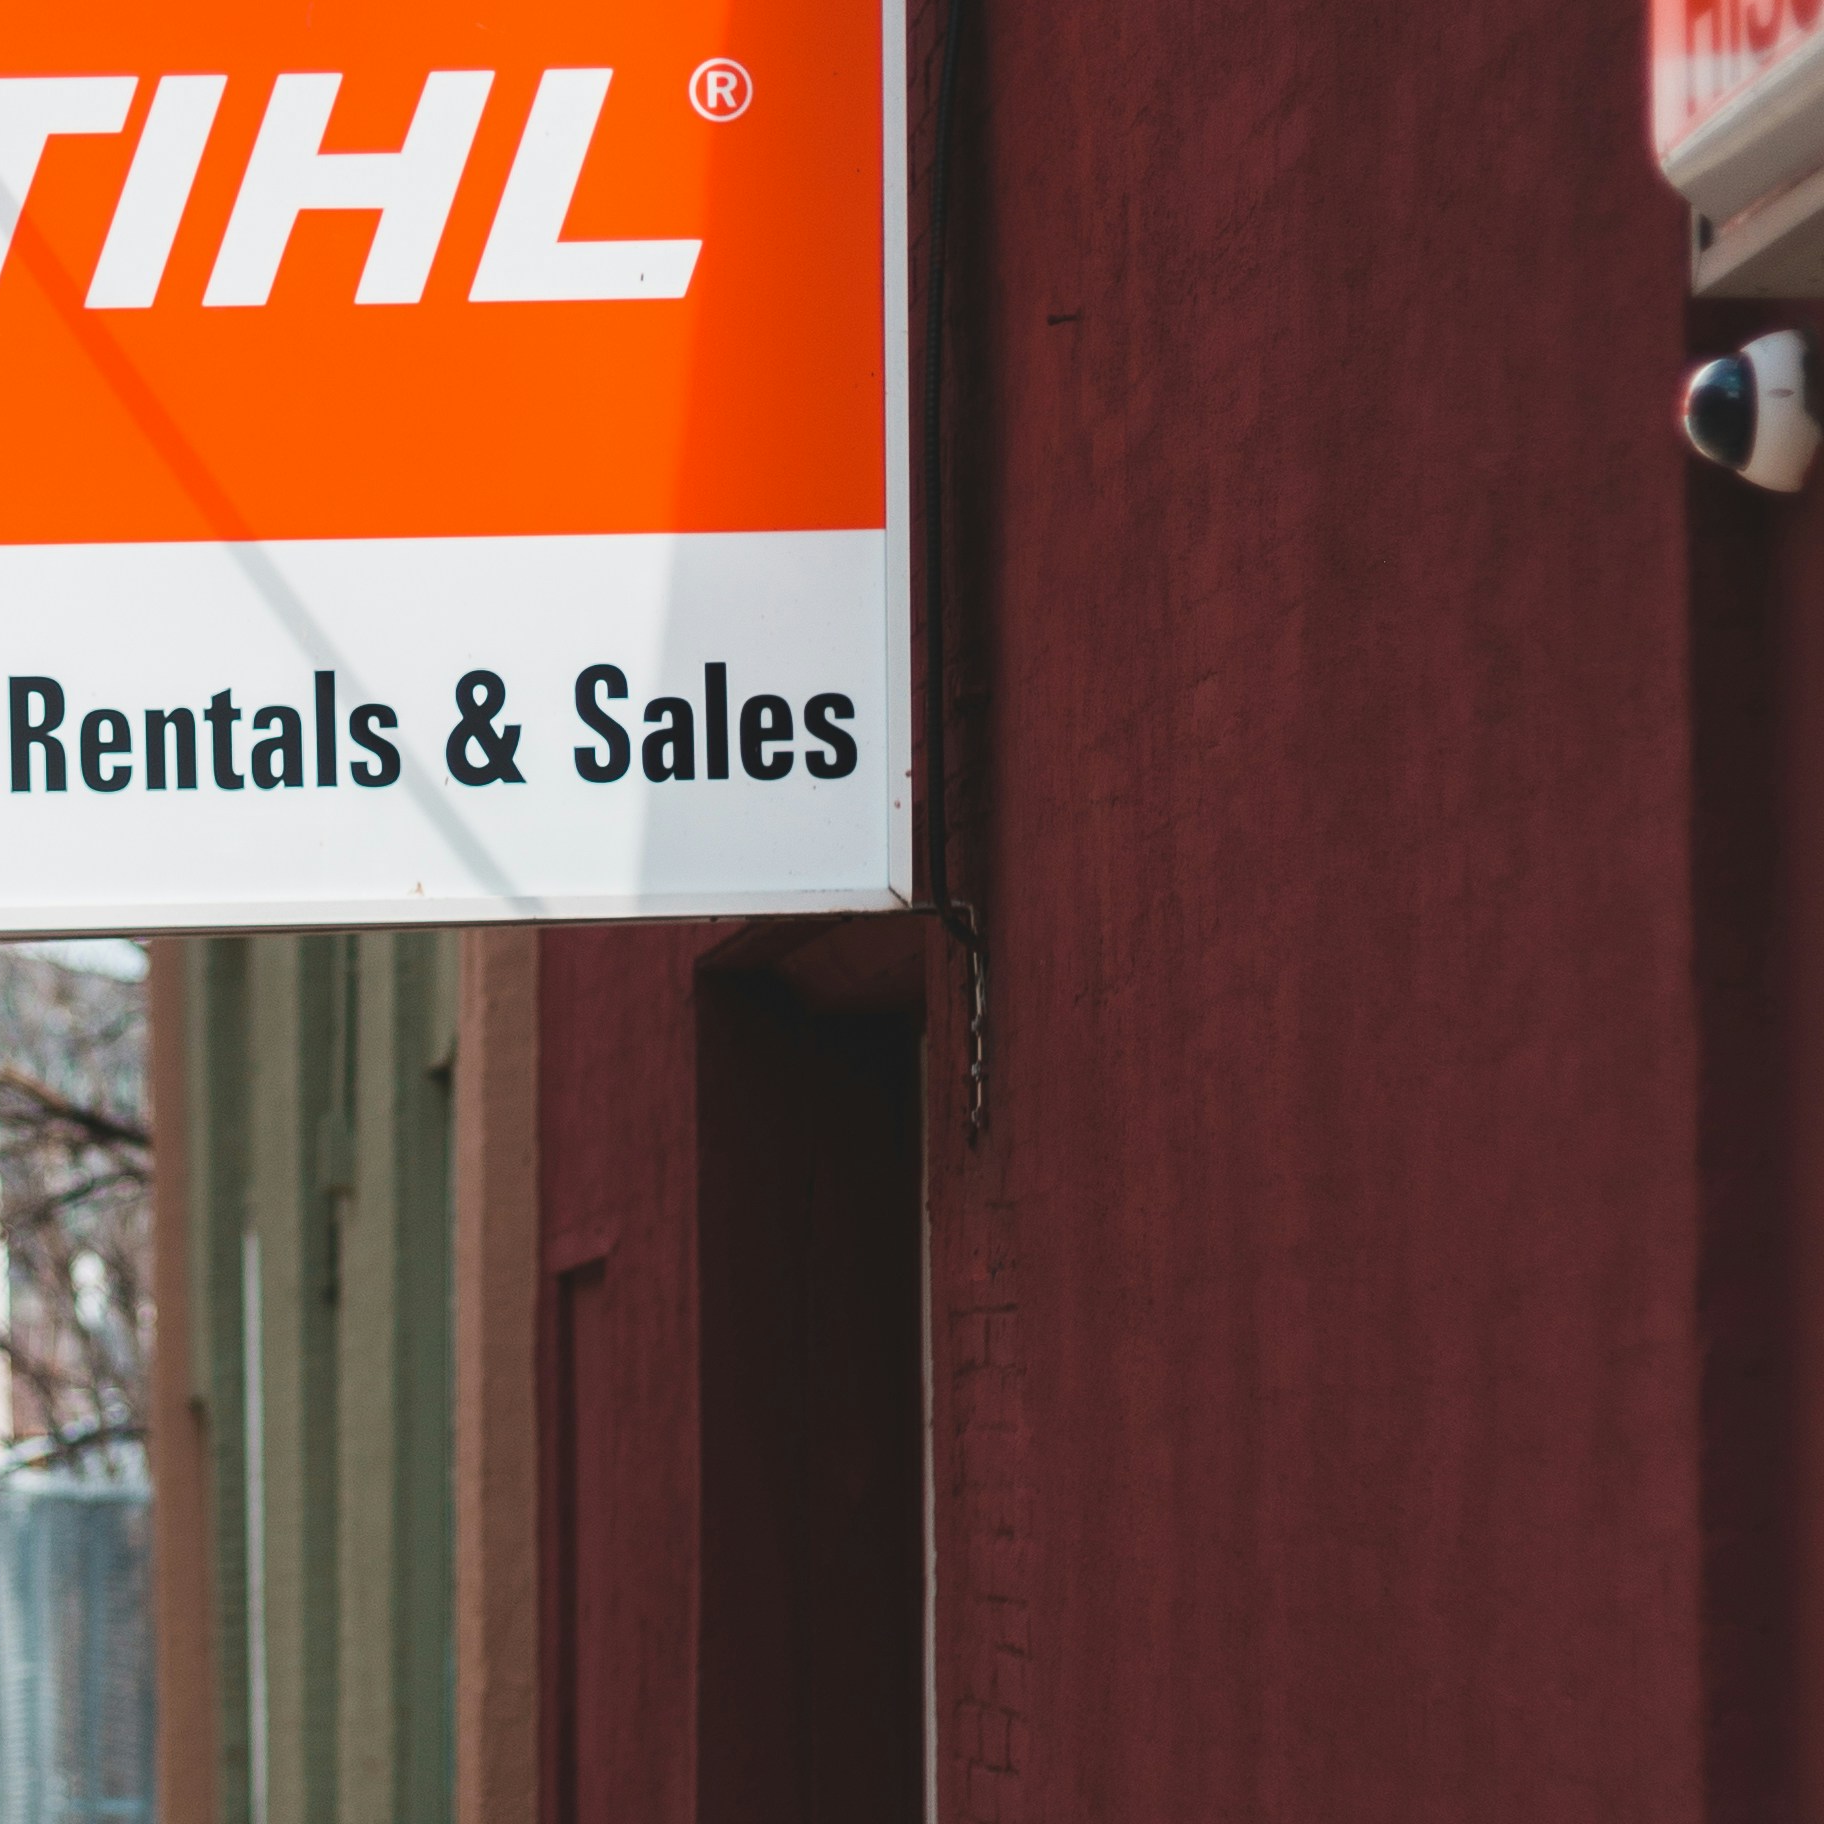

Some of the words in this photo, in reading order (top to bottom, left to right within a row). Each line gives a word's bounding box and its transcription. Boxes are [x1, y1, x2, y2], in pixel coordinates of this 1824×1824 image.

[9, 670, 403, 793] Rentals
[445, 669, 528, 787] &
[574, 661, 859, 785] Sales
